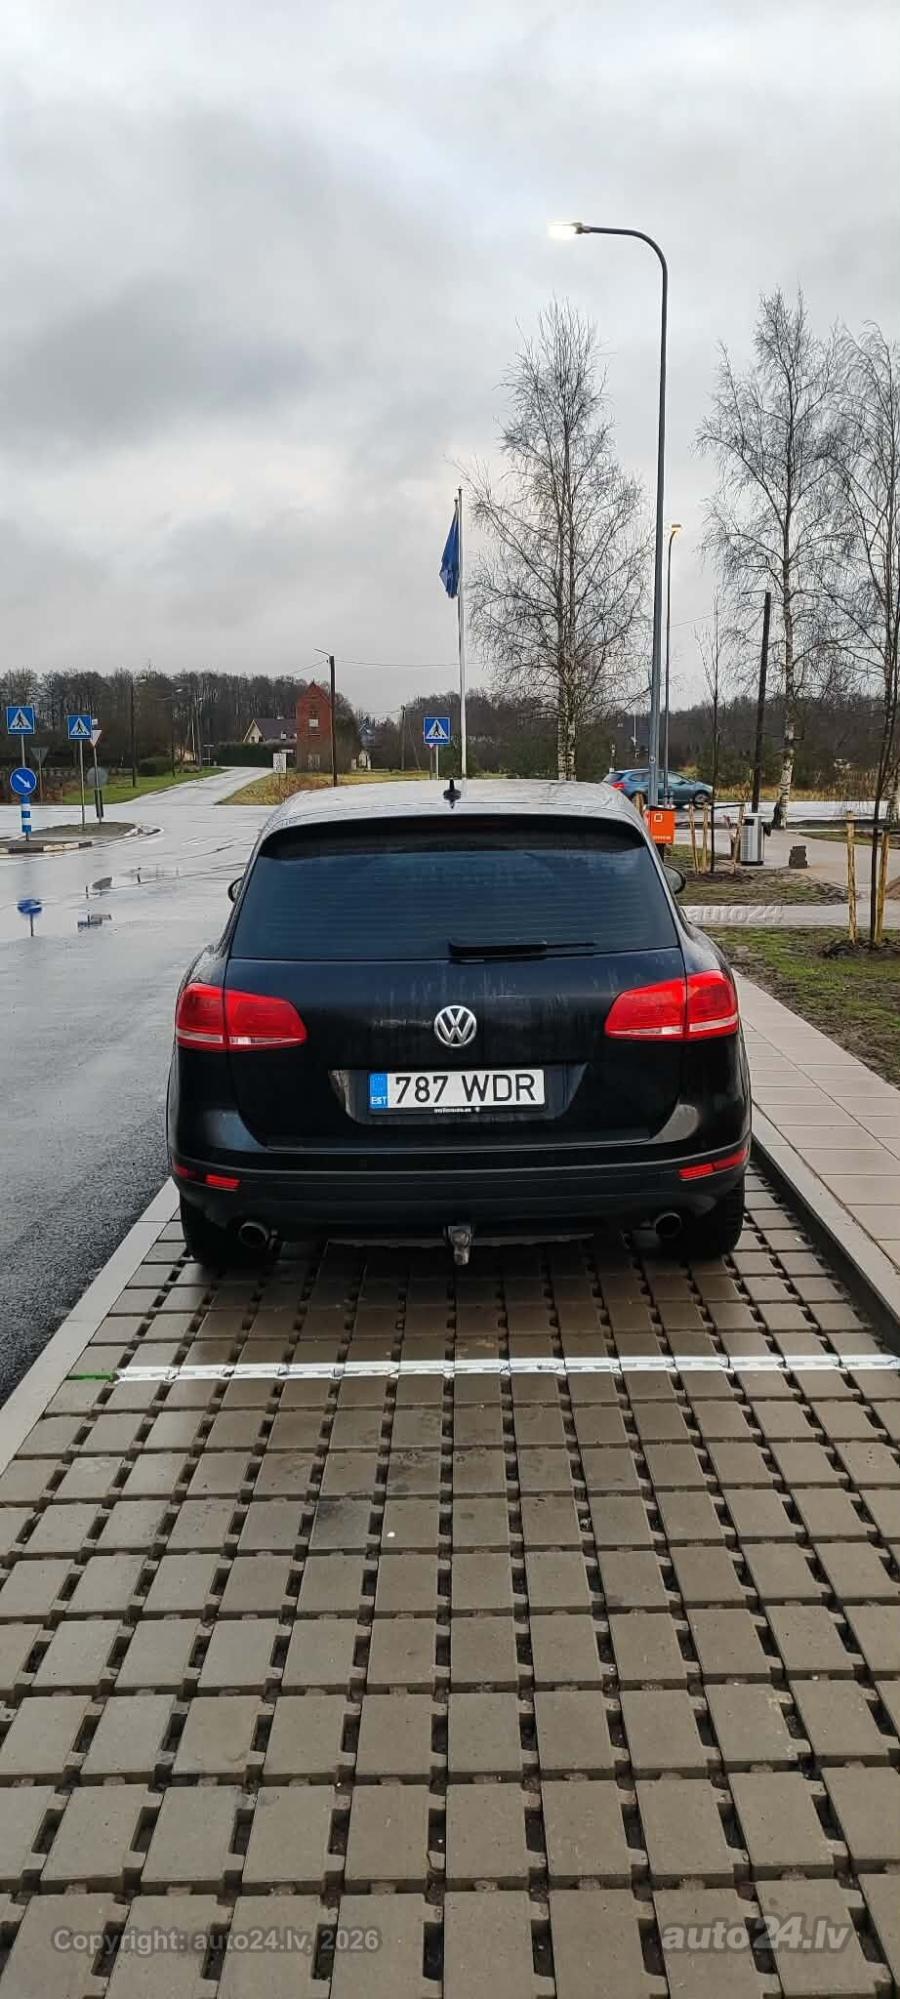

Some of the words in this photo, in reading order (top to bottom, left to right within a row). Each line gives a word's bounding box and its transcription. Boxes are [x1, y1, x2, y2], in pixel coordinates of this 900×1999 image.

[434, 1004, 478, 1048] VW
[371, 1096, 387, 1105] EST
[395, 1076, 449, 1104] 787
[461, 1073, 536, 1103] WDR
